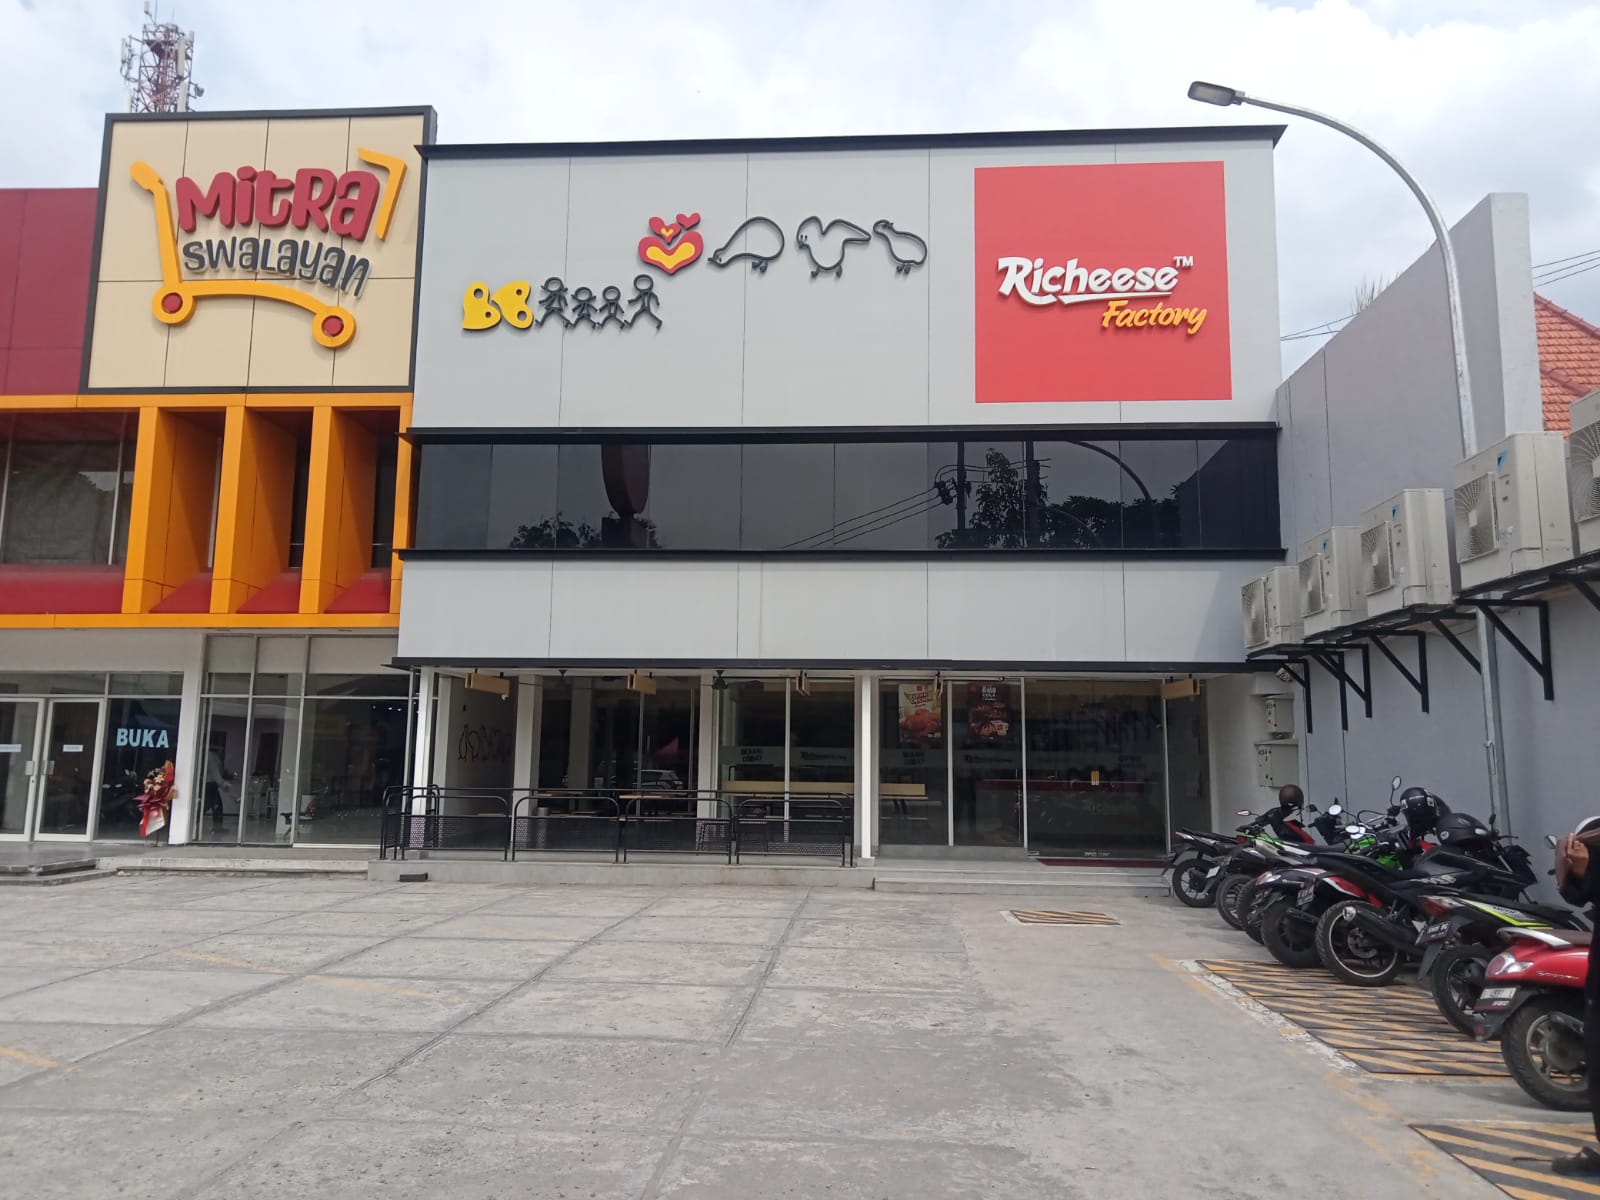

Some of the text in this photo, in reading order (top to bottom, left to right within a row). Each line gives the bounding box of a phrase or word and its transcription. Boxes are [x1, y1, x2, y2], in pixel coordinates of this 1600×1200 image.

[176, 166, 380, 242] MitRa
[997, 256, 1194, 306] Richeese TM
[1102, 299, 1208, 335] Factory
[116, 728, 169, 748] BUKA
